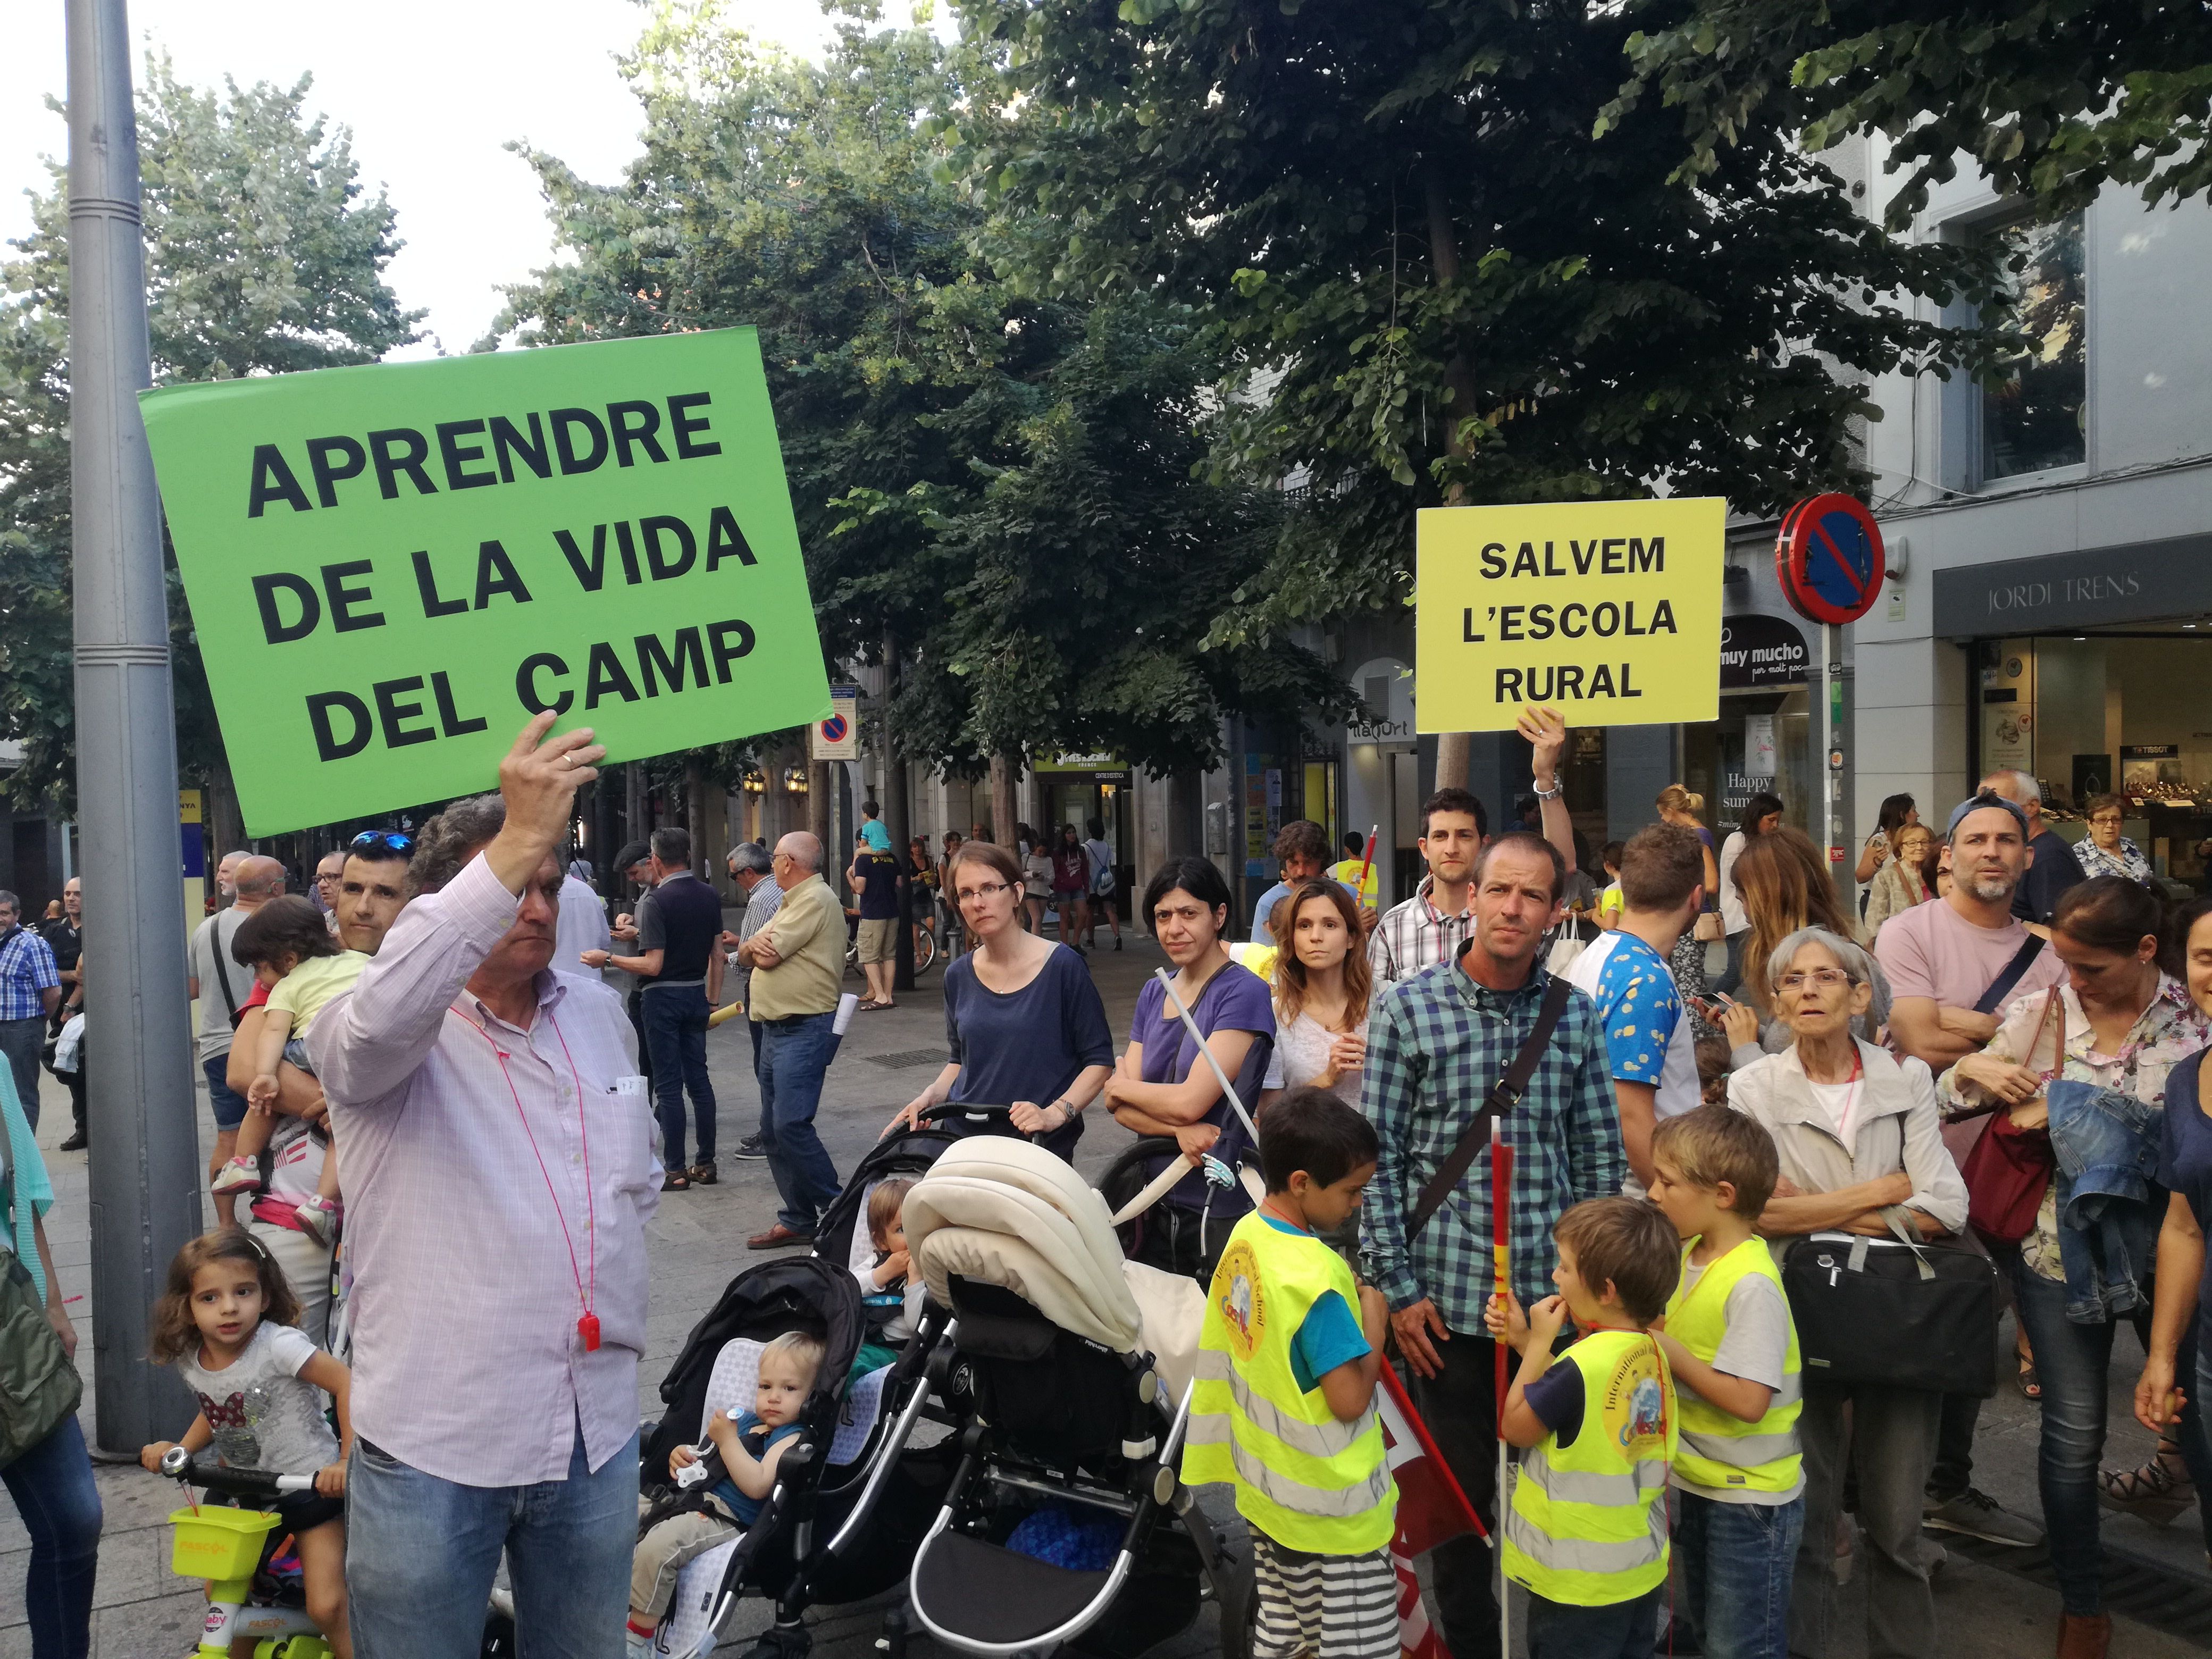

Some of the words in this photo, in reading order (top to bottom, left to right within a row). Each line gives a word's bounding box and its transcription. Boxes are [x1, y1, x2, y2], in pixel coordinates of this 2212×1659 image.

[248, 392, 722, 518] APRENDRE
[252, 559, 386, 644] DE
[411, 540, 533, 618] LA
[552, 506, 758, 591] VIDA
[1480, 537, 1664, 579] SALVEM
[1987, 582, 2050, 615] JORDI
[2063, 571, 2139, 601] TRENS
[1464, 600, 1677, 642] L'ESCOLA
[1721, 650, 1748, 667] muy
[1752, 642, 1803, 663] mucho
[1752, 668, 1766, 682] per
[1768, 663, 1787, 673] molt
[1789, 665, 1803, 680] poc
[306, 671, 488, 762] DEL
[516, 620, 759, 716] CAMP
[1496, 664, 1641, 702] RURAL
[1728, 773, 1772, 793] Happy
[1216, 1245, 1249, 1280] International
[1255, 1284, 1264, 1327] School
[1605, 1344, 1647, 1411] International
[205, 1614, 228, 1625] aby
